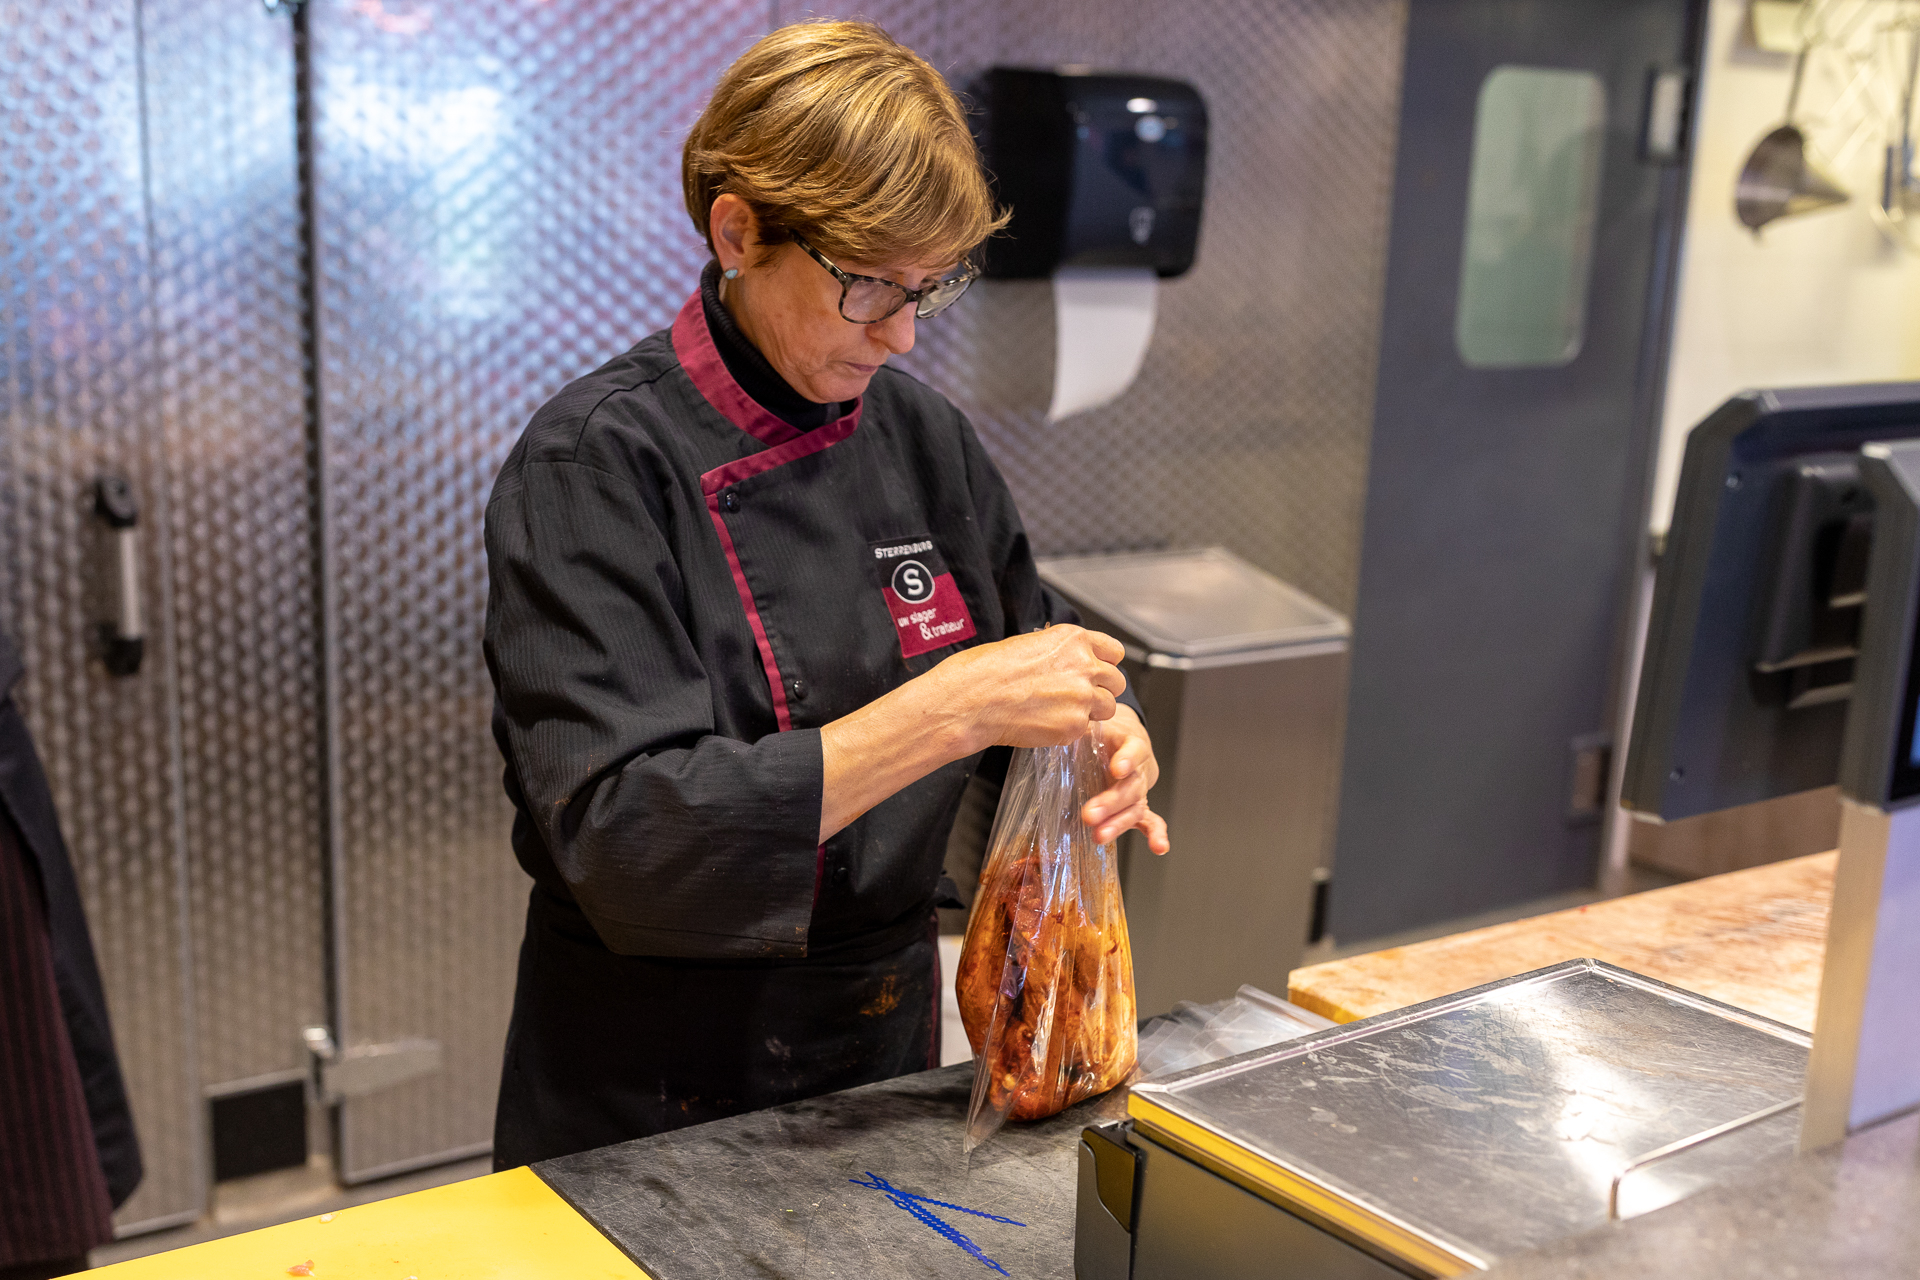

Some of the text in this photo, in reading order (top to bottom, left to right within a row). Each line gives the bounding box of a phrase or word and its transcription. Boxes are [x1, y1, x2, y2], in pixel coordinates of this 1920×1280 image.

[903, 568, 924, 596] S
[909, 607, 937, 624] slager
[919, 618, 965, 640] & traiteur
